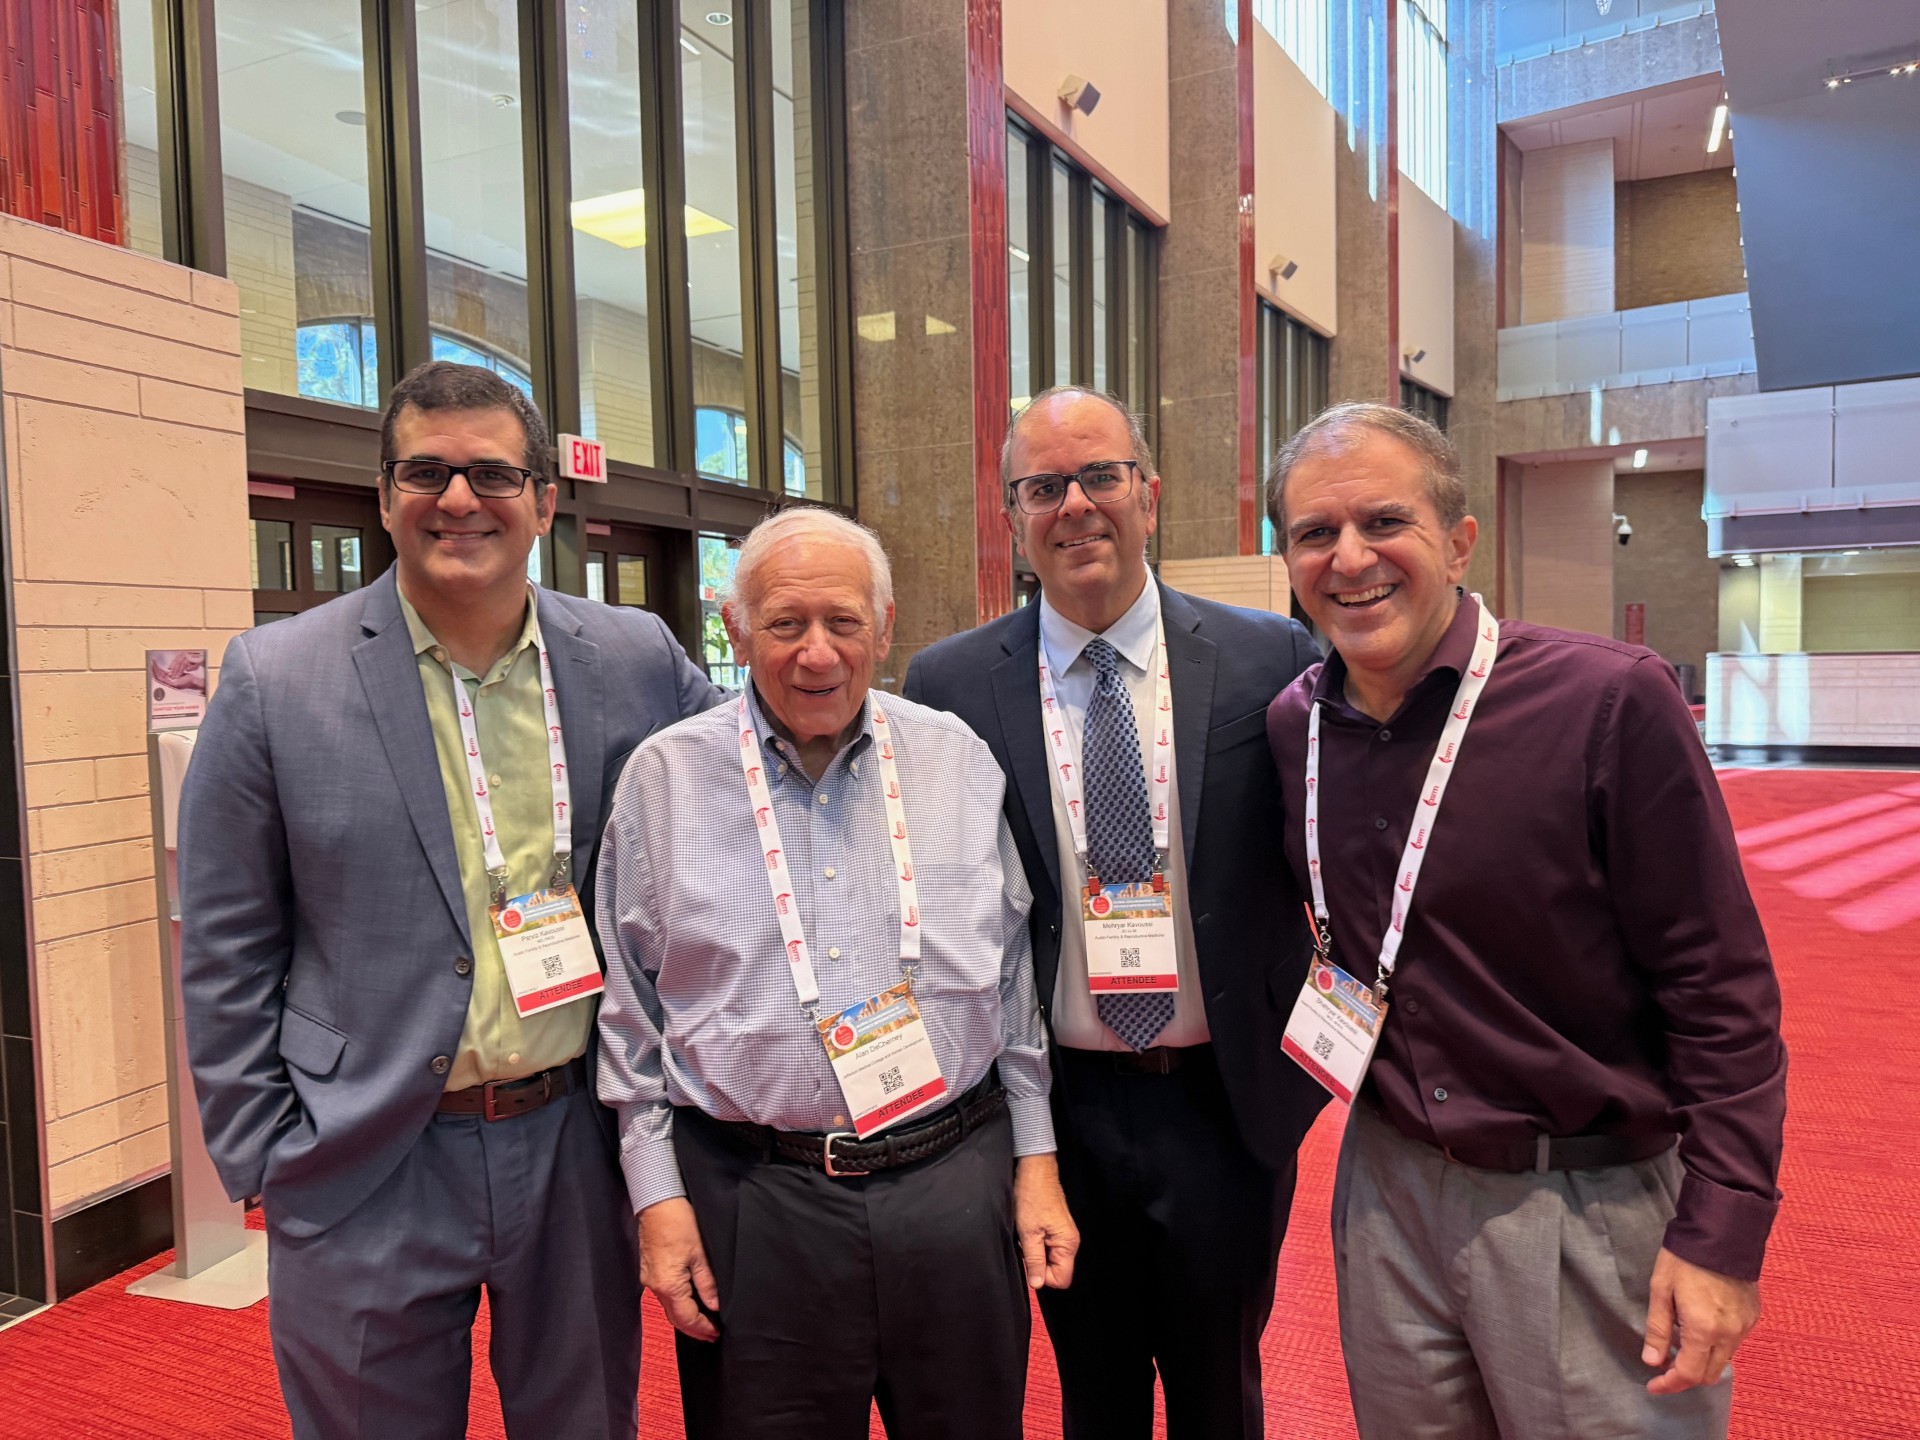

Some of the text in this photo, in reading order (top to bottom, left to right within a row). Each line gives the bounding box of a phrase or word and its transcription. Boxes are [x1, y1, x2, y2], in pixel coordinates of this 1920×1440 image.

[572, 440, 601, 478] EXIT
[1478, 658, 1488, 675] asrm
[1459, 699, 1470, 718] asrm
[1444, 742, 1455, 762] asrm
[1428, 785, 1440, 805] asrm
[1416, 828, 1425, 848] asrm
[1404, 871, 1413, 890] asrm
[540, 979, 583, 1000] ATTENDEE
[1110, 976, 1157, 984] ATTENDEE
[1299, 1052, 1336, 1087] ATTENDEE
[878, 1088, 926, 1118] ATTENDEE
